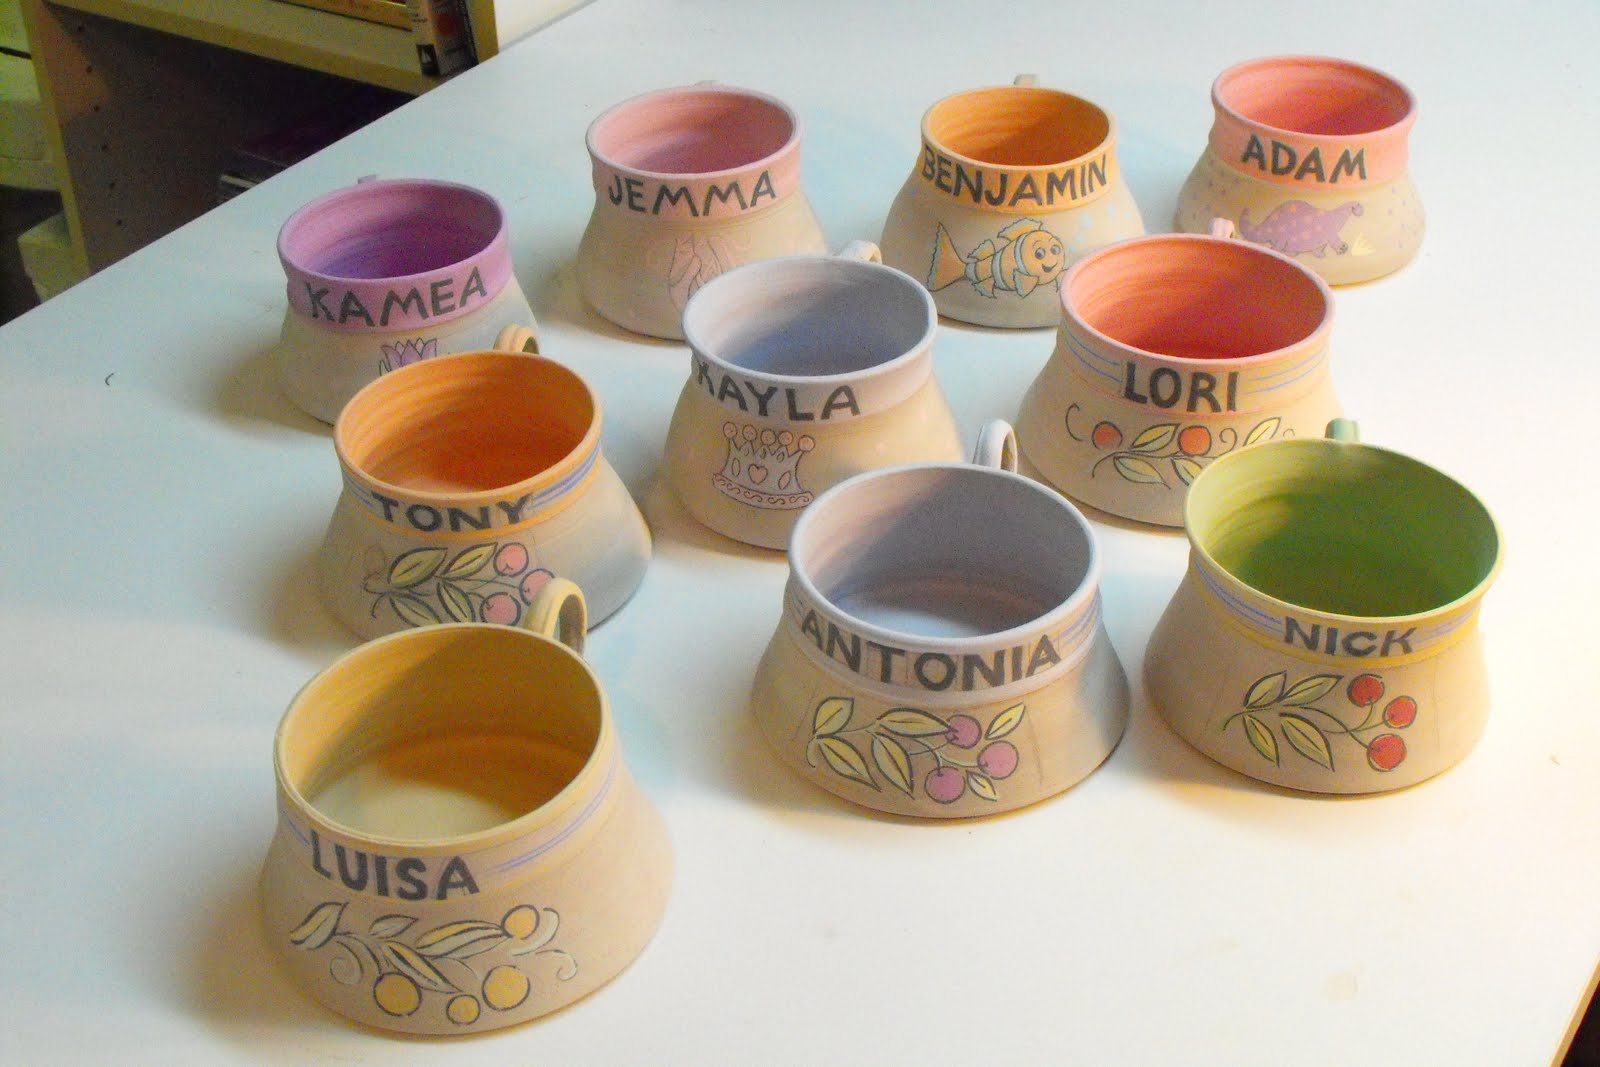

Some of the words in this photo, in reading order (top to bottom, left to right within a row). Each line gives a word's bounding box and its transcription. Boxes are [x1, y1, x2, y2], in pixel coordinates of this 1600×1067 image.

[921, 144, 1107, 208] BENJAMIN
[1241, 133, 1367, 183] ADAM
[607, 170, 777, 217] JEMMA
[304, 267, 488, 327] KAMEA
[698, 361, 860, 421] KAYLA
[1124, 361, 1239, 413] LORI
[371, 490, 533, 532] TONY
[802, 608, 1061, 692] ANTONIA
[1284, 616, 1417, 657] NICK
[311, 829, 480, 900] LUISA
